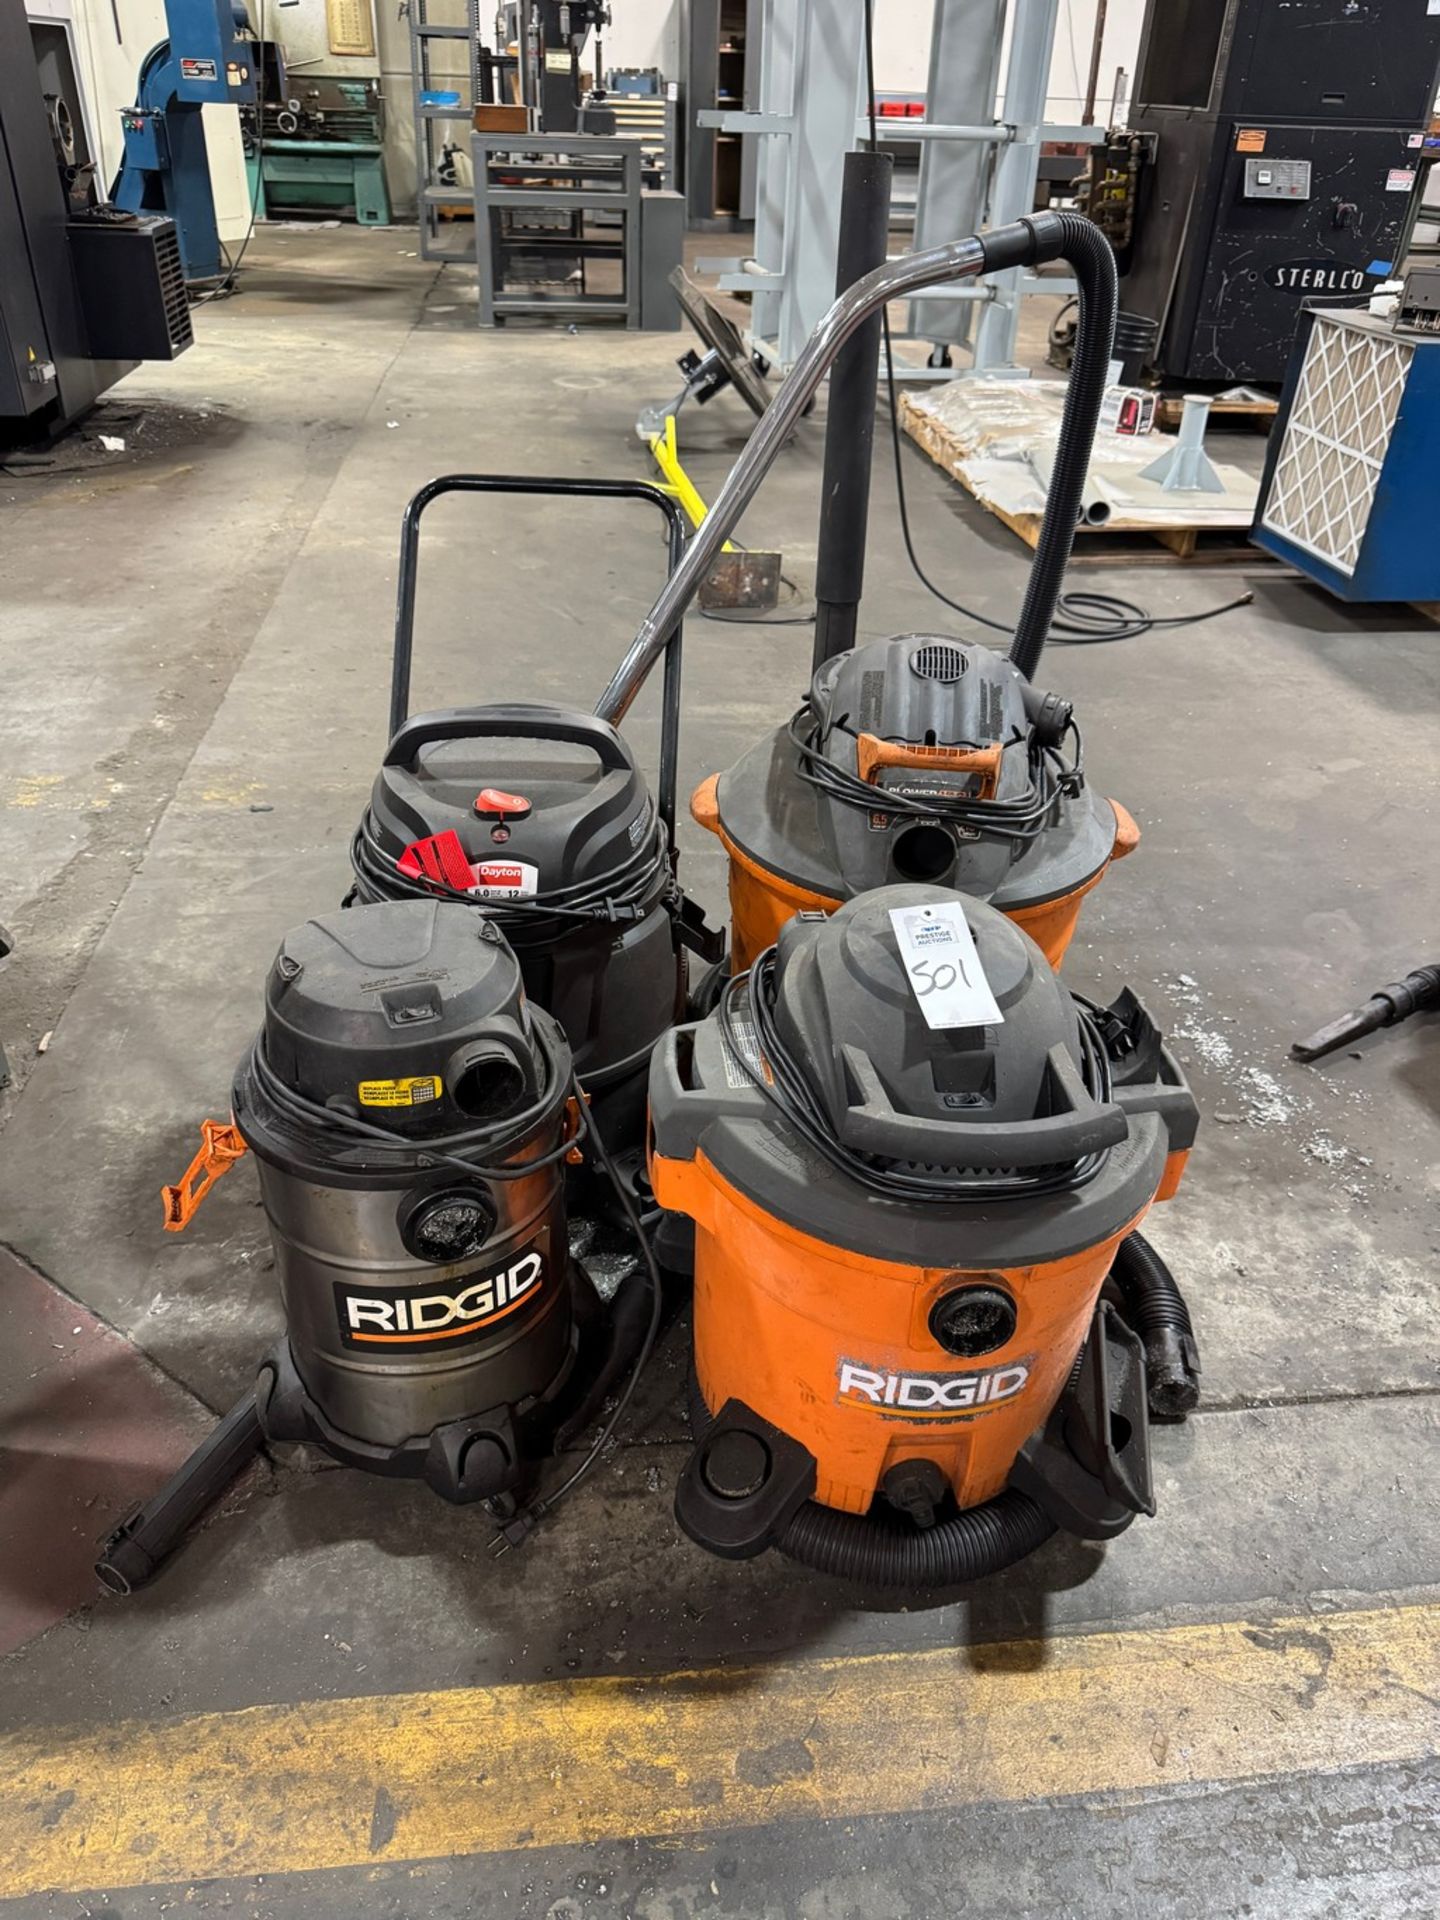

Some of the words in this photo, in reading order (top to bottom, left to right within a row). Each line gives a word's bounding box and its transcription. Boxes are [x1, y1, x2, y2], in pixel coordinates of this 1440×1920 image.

[1274, 267, 1364, 290] STERLCO
[480, 866, 522, 878] Dayton
[915, 930, 951, 940] PRESTIGE
[918, 936, 953, 945] AUCTIONS
[911, 958, 973, 996] 501
[346, 1252, 543, 1331] RIDGID
[839, 1363, 1029, 1408] RIDGID
